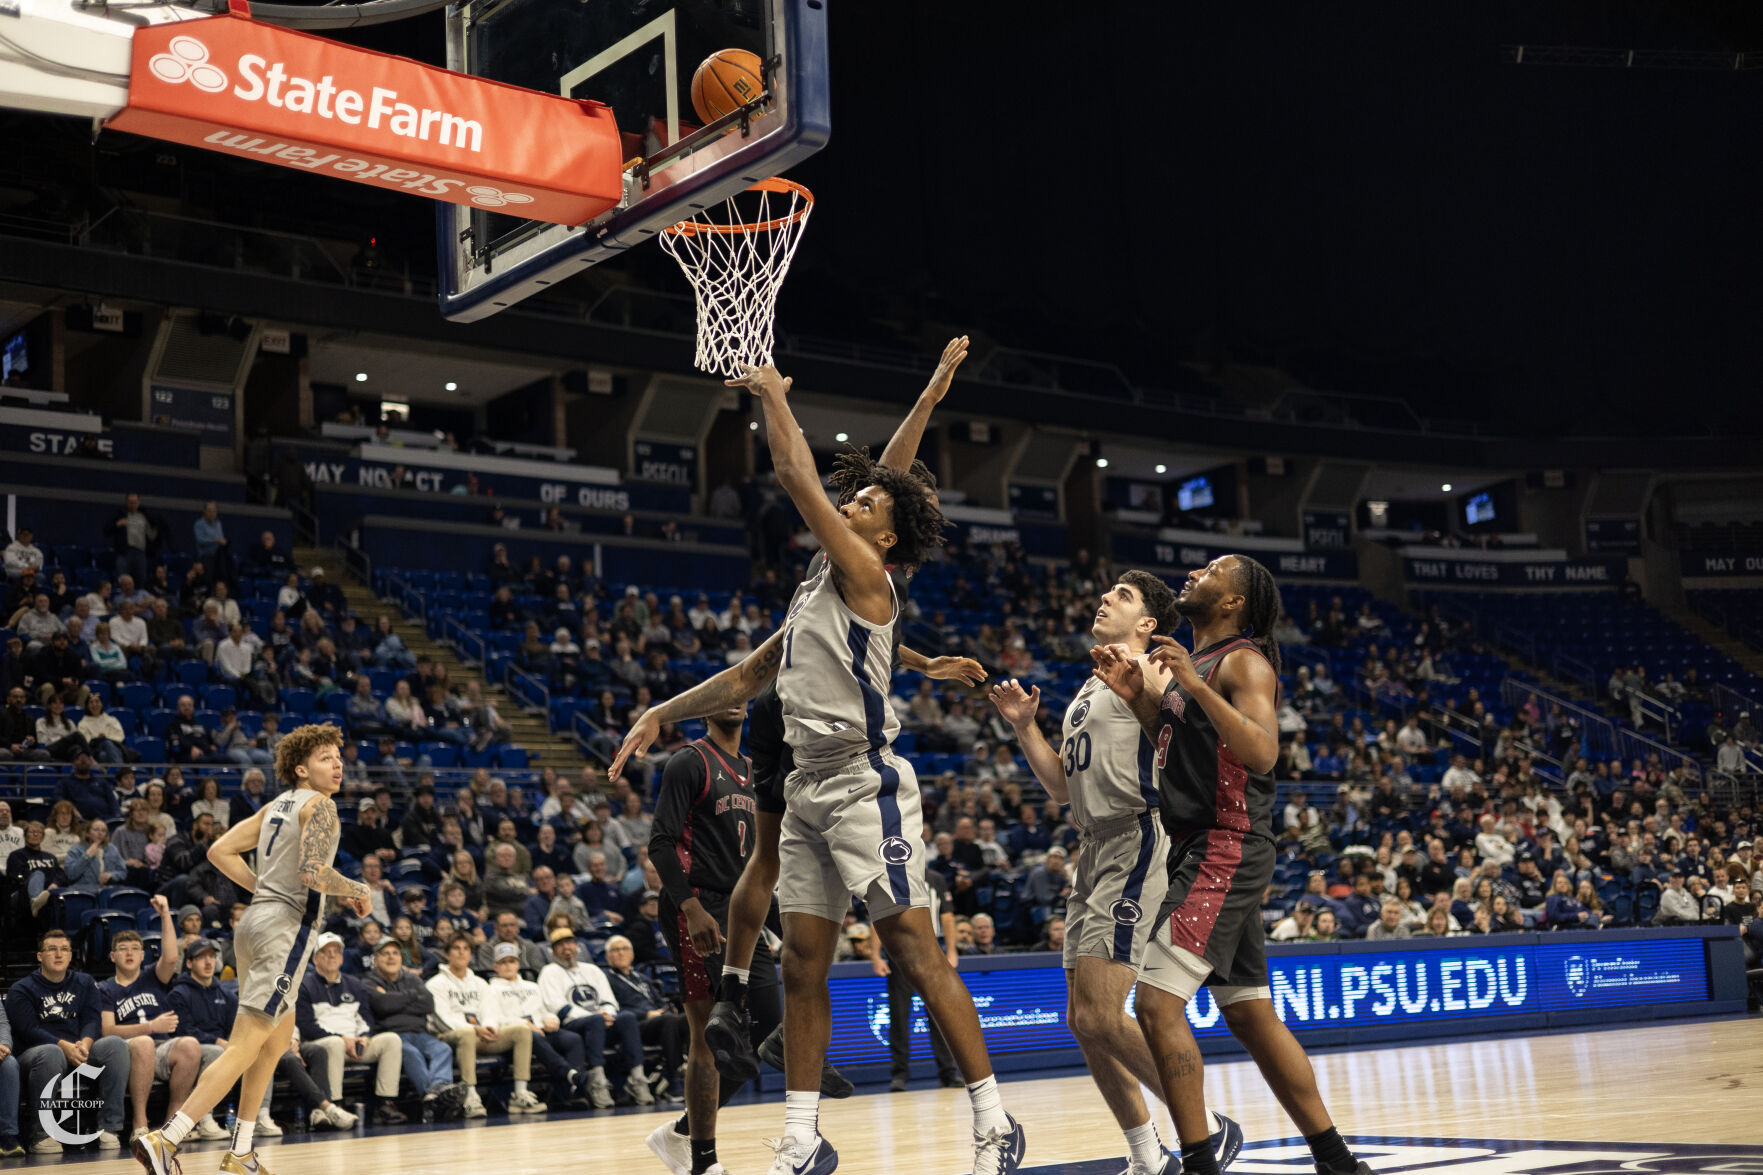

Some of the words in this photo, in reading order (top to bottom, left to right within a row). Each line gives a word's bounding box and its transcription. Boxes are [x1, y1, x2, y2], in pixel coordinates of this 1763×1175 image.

[29, 432, 114, 458] STAE
[304, 462, 345, 485] MAY
[540, 482, 568, 504] OF
[578, 487, 629, 511] OURS
[1155, 544, 1175, 563] TO
[1180, 547, 1208, 565] ONE
[1279, 555, 1327, 573] HEART
[1412, 561, 1448, 577] THAT
[1455, 564, 1499, 580] LOVES
[1524, 566, 1555, 580] THY
[1705, 557, 1736, 571] MAY
[785, 626, 795, 669] 1
[1064, 731, 1092, 777] 30
[715, 795, 730, 816] NC
[269, 817, 284, 857] 7
[116, 1000, 135, 1021] PENN
[134, 992, 159, 1008] STATE
